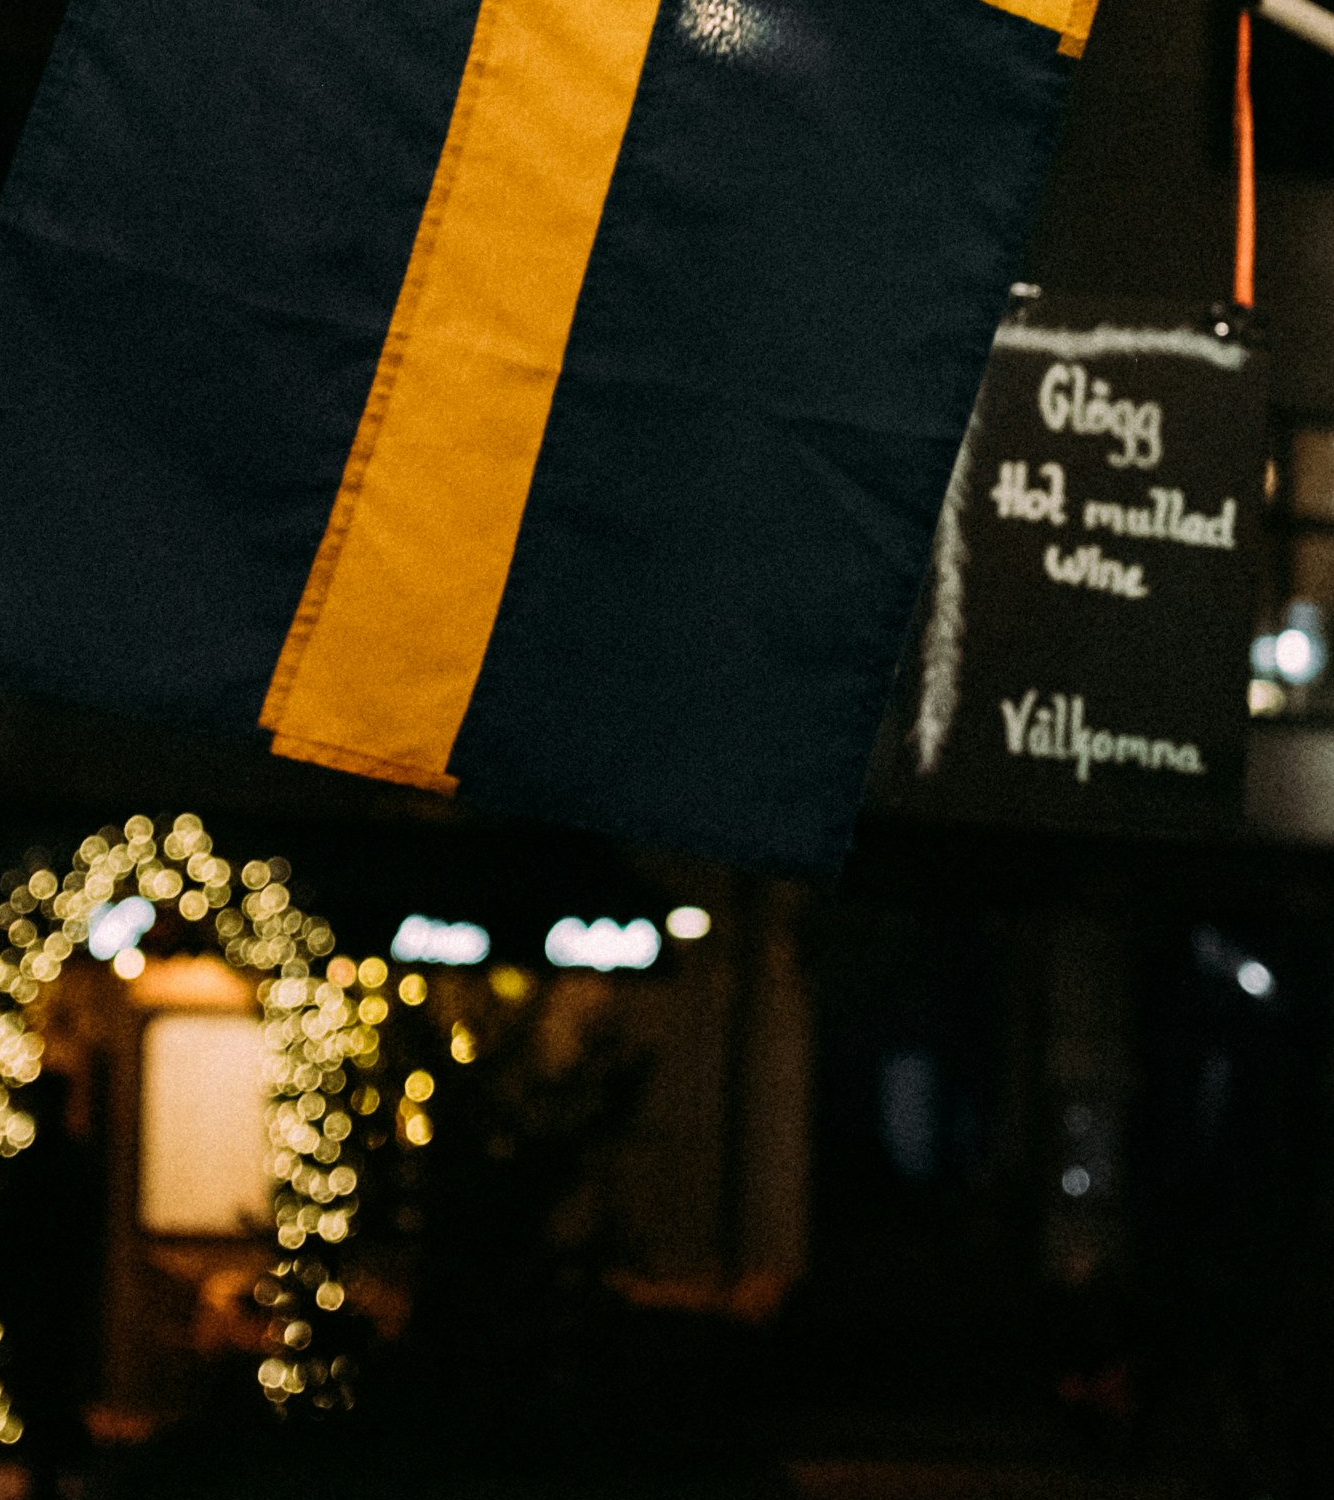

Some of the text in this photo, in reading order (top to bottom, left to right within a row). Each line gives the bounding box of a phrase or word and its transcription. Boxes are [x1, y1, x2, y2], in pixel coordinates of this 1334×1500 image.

[1039, 362, 1165, 470] Glögg
[990, 459, 1067, 526] Hot
[1044, 544, 1149, 600] wine
[1000, 688, 1206, 783] Välkomna
